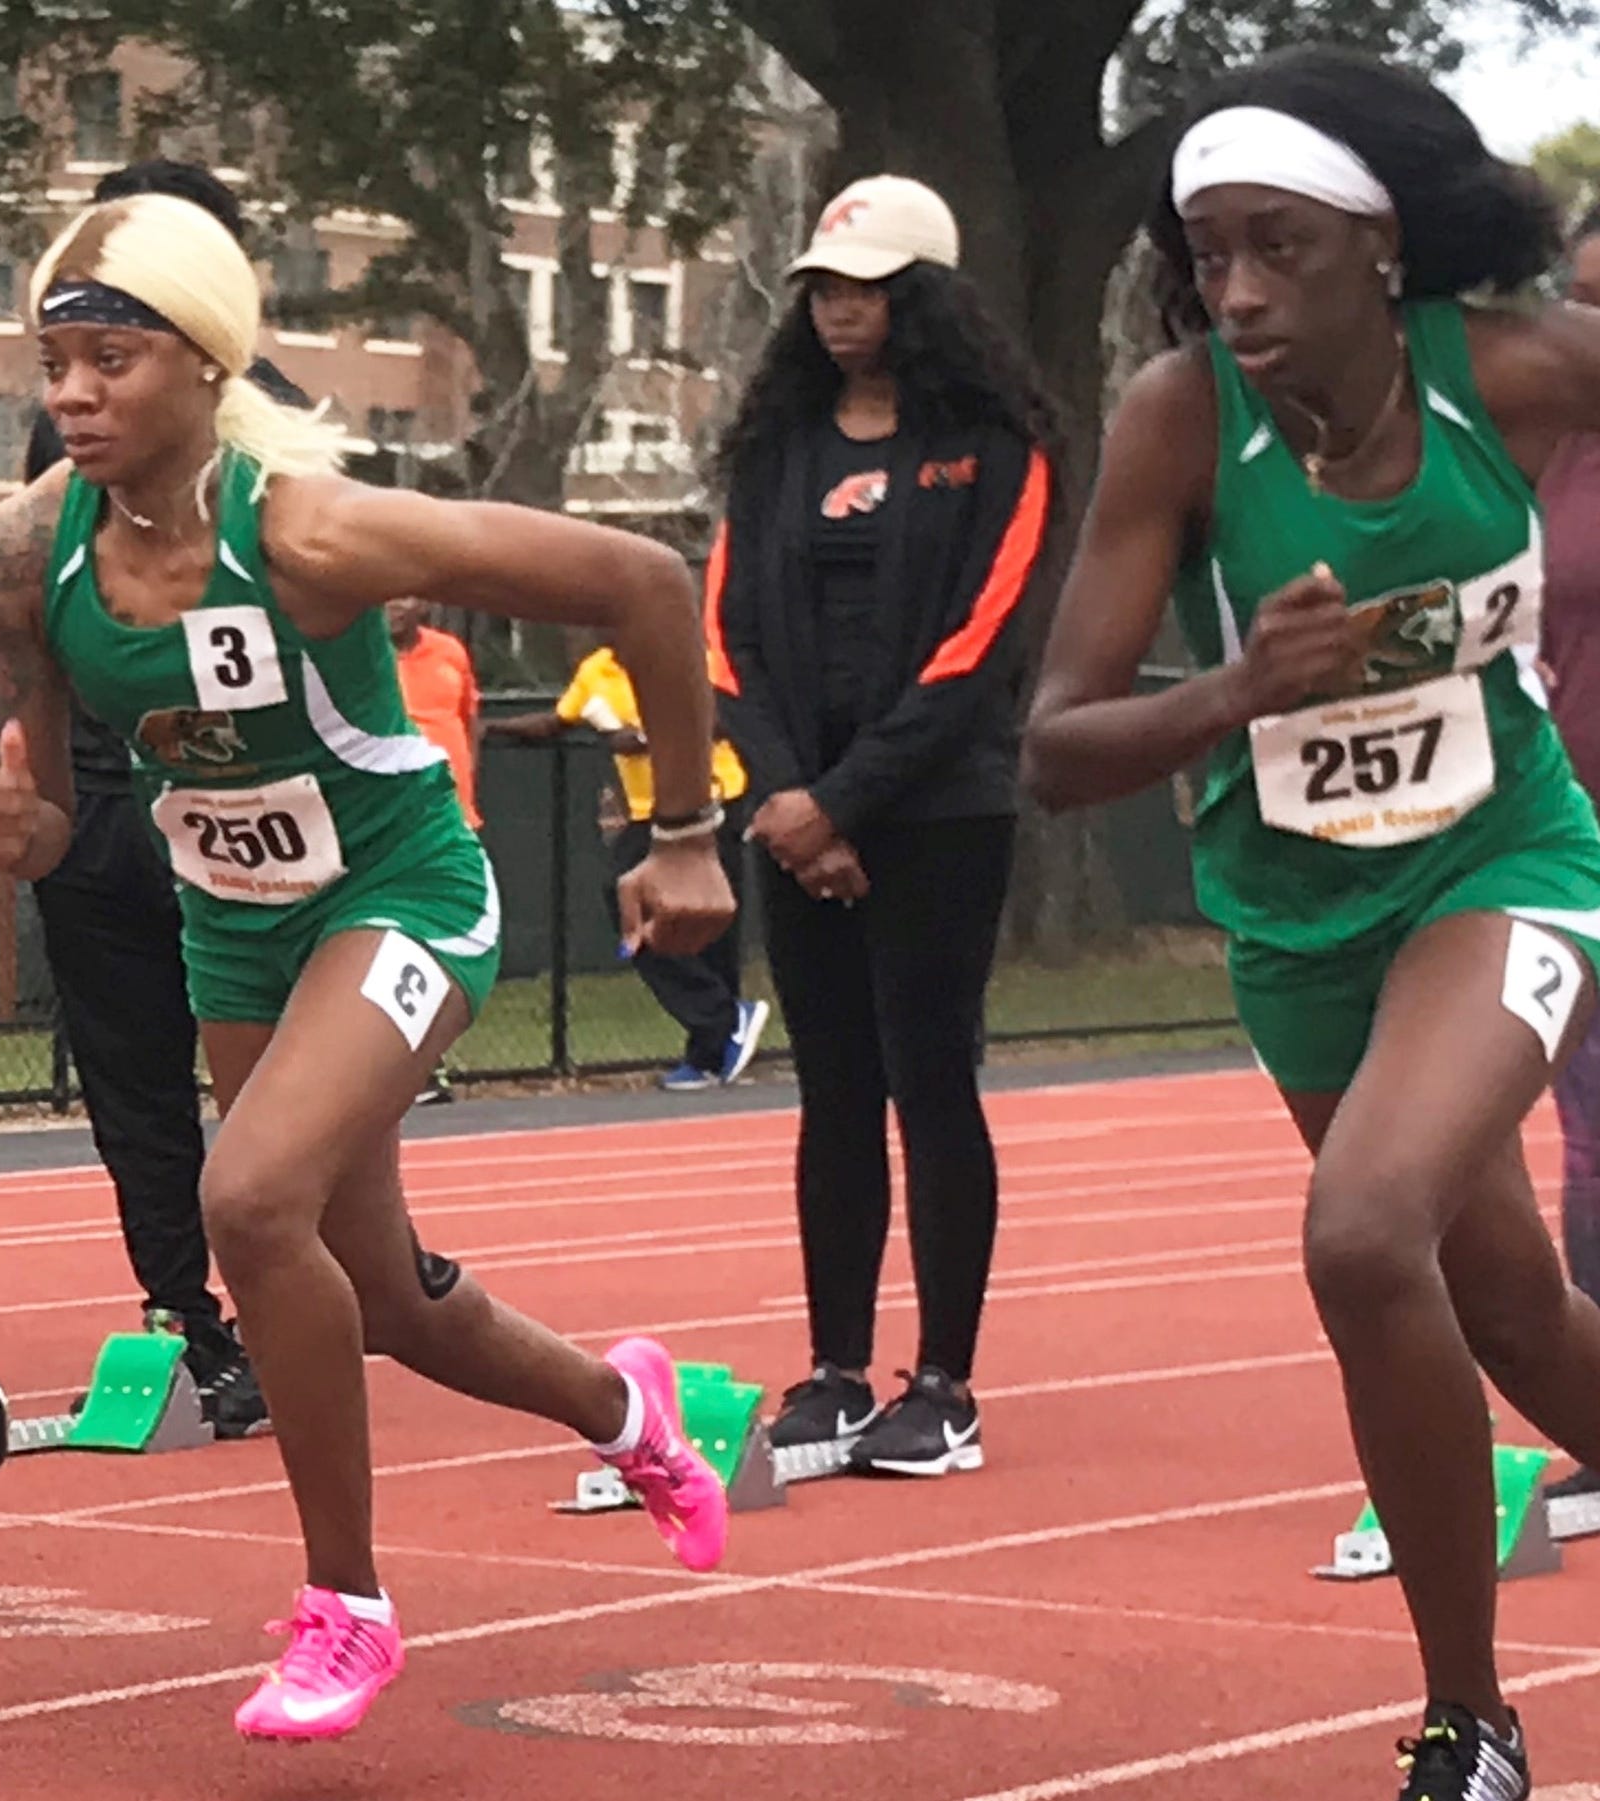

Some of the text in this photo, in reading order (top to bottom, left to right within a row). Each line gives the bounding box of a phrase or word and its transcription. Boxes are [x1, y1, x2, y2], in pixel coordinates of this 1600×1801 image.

[211, 626, 254, 688] 3
[1300, 714, 1444, 804] 257
[182, 811, 307, 869] 250
[393, 963, 428, 1017] 3
[1532, 955, 1562, 1018] 2
